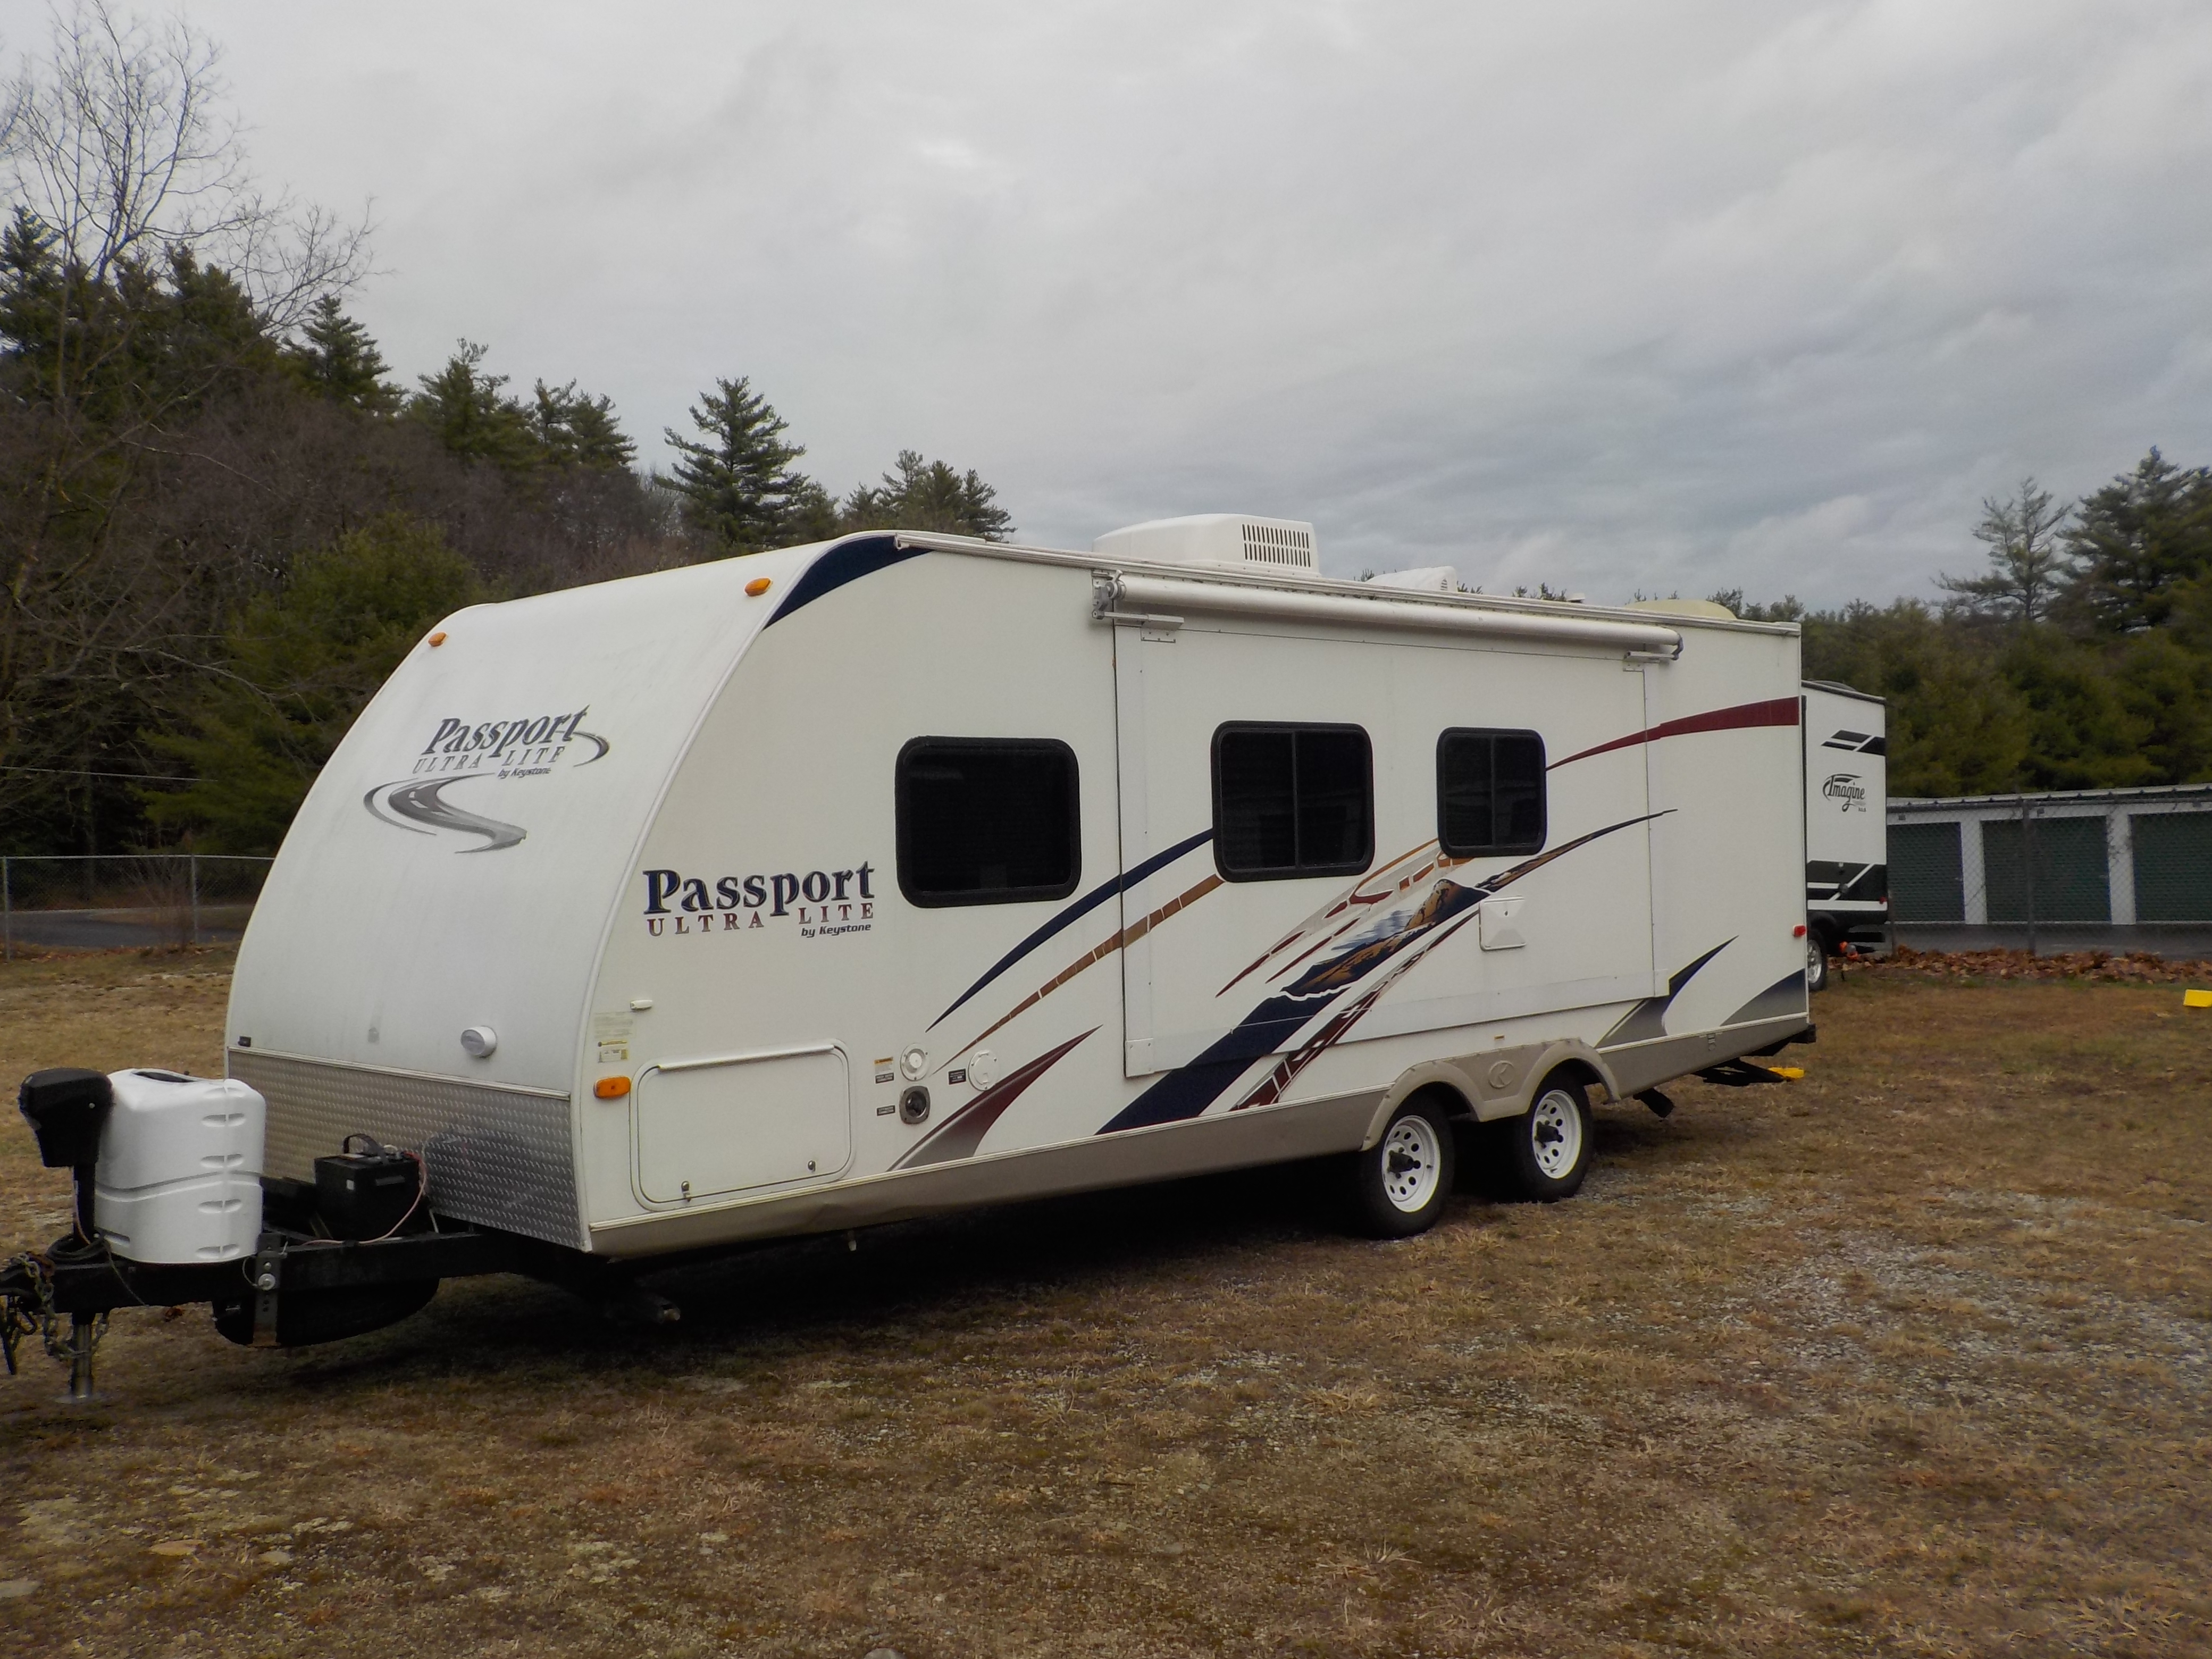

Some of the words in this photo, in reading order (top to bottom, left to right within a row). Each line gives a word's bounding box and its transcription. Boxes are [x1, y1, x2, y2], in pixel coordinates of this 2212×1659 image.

[421, 704, 590, 758] Passport
[412, 753, 482, 774] ULTRA
[501, 745, 565, 766] LITE
[497, 768, 509, 778] by
[511, 767, 551, 778] Keystone
[1824, 774, 1865, 812] Imagine
[642, 860, 875, 917] Passport
[646, 911, 765, 937] ULTRA
[798, 902, 874, 925] LITE
[801, 927, 815, 937] by
[819, 923, 871, 936] Keystone
